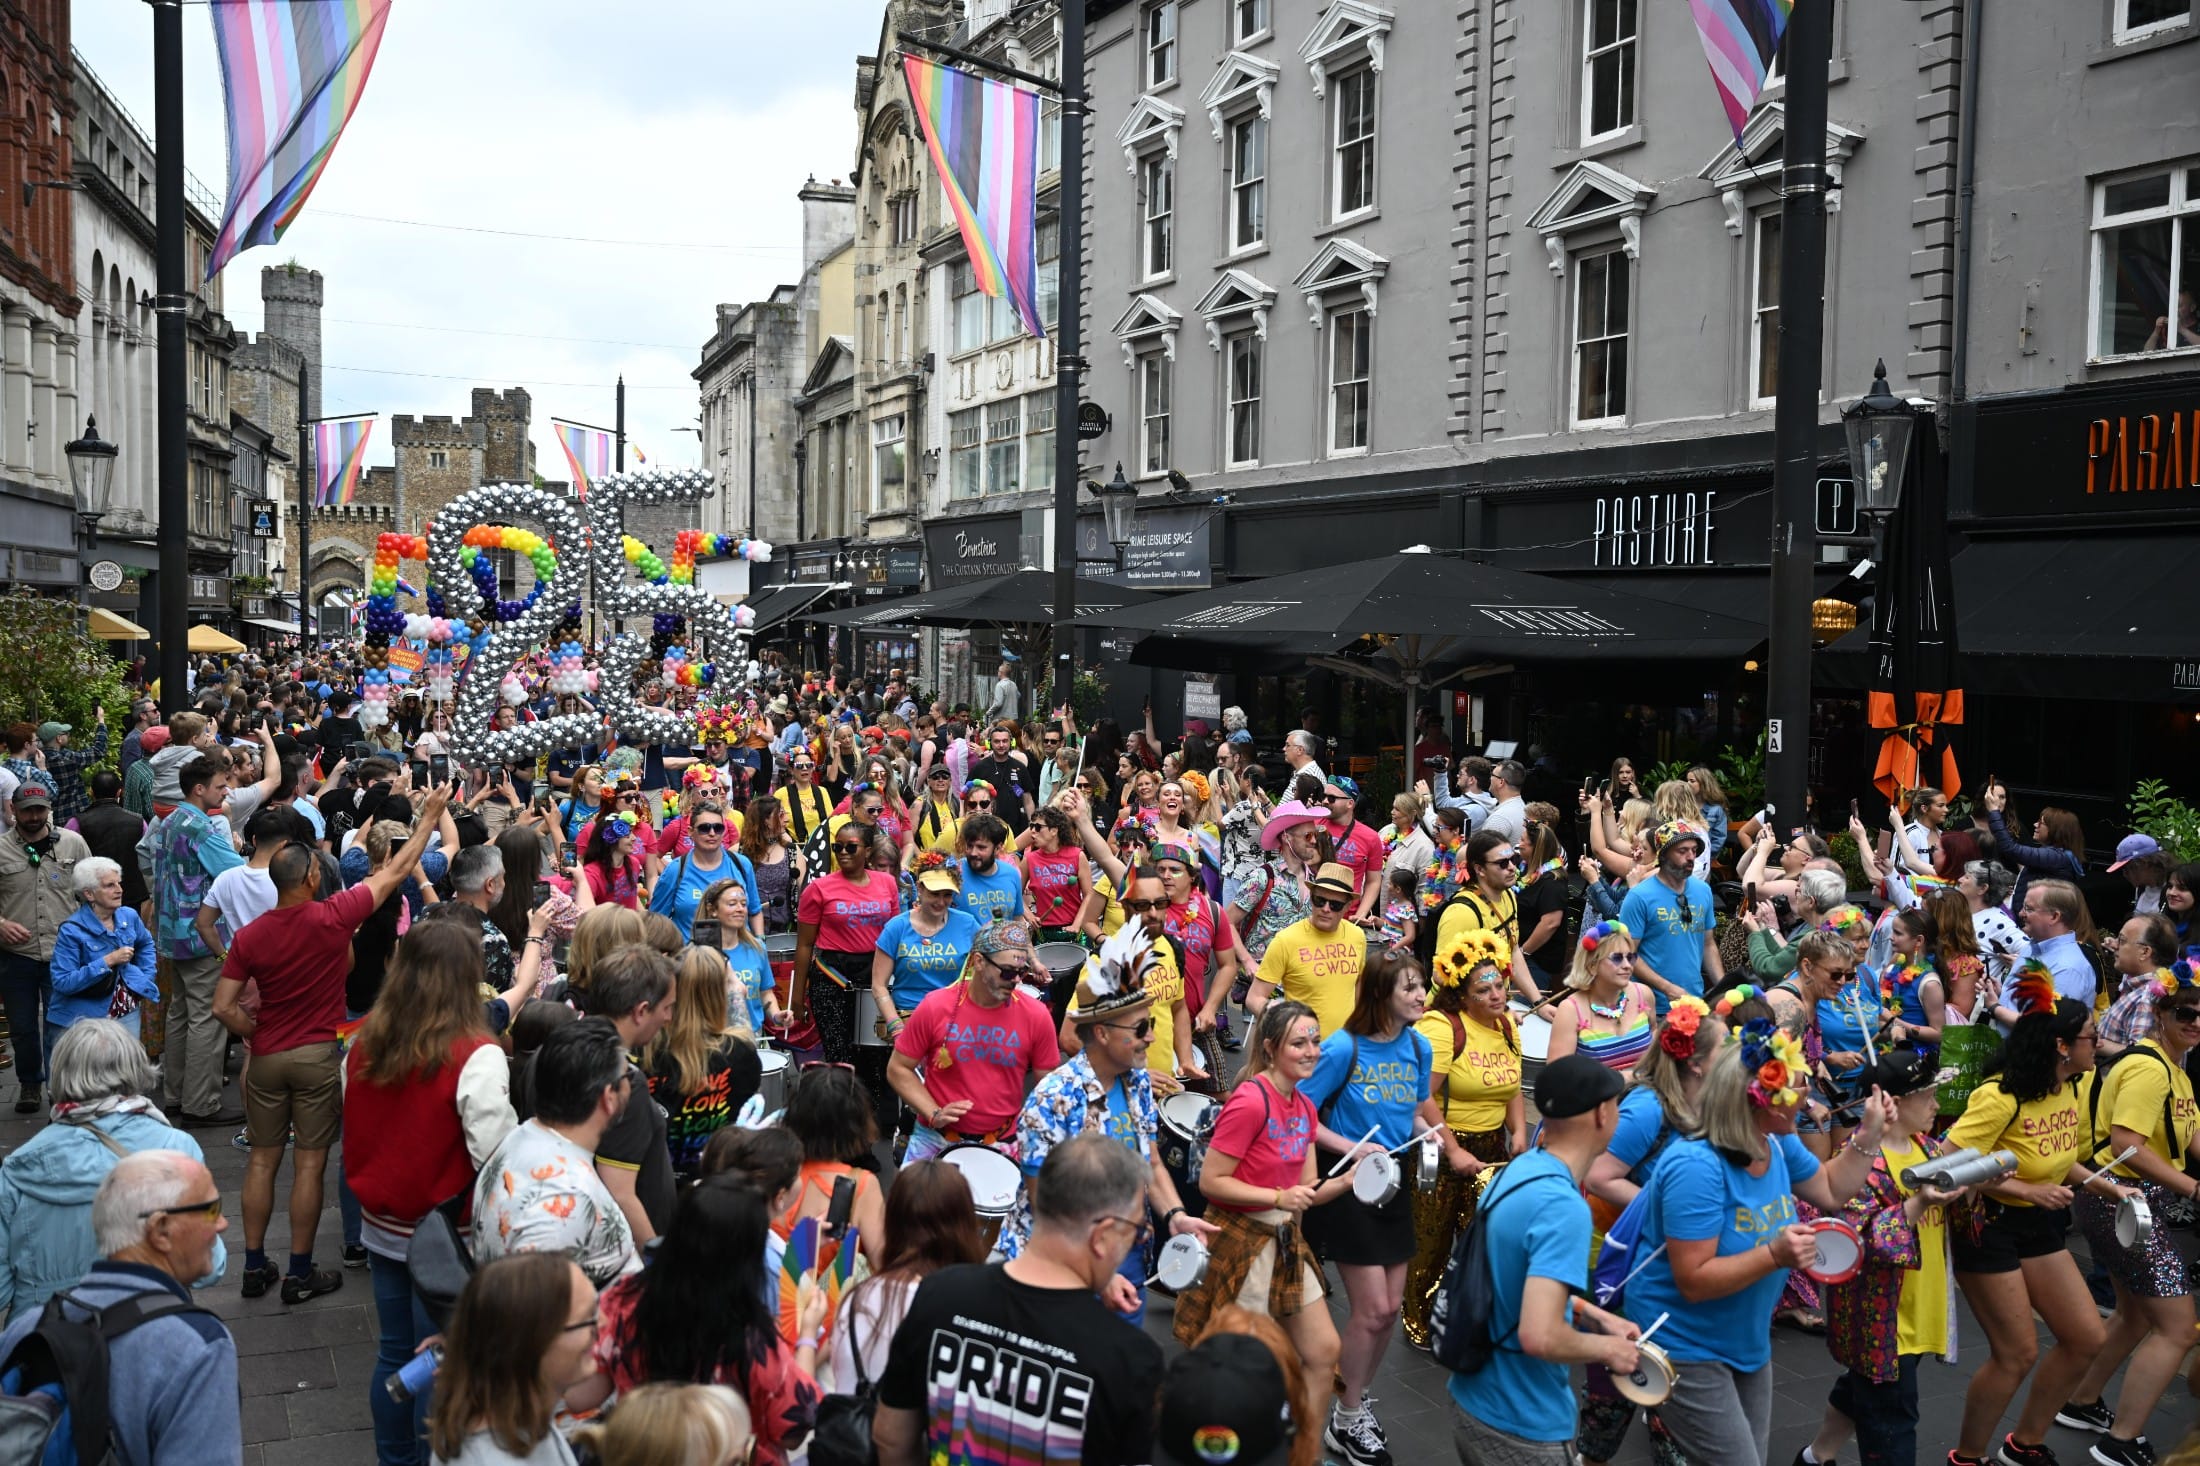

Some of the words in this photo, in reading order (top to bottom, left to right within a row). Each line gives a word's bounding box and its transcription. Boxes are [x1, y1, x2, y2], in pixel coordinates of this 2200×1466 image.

[253, 505, 272, 513] BLUE
[1832, 483, 1842, 529] P
[254, 528, 272, 536] BELL
[1593, 491, 1716, 566] PASTURE
[1147, 533, 1172, 546] LEISURE
[1173, 532, 1193, 545] SPACE
[941, 564, 954, 576] THE
[954, 562, 981, 576] CURTAIN
[1085, 567, 1114, 577] QUARTER
[1480, 609, 1625, 630] PASTURE
[1770, 722, 1778, 734] 5
[1770, 738, 1779, 751] A
[1033, 863, 1076, 877] BARRA
[1041, 874, 1070, 888] CWD
[968, 891, 1013, 905] BARRA
[836, 901, 891, 915] BARRA
[898, 942, 958, 957] BARRA
[1299, 943, 1357, 962] BARRA
[907, 957, 958, 972] CWDA
[1313, 959, 1359, 976] CWDA
[946, 1023, 1021, 1048] BARRA
[956, 1044, 1017, 1068] CWDA
[1350, 1062, 1416, 1084] BARRA
[682, 1087, 731, 1114] LOVE
[1362, 1084, 1417, 1104] CWDA
[683, 1106, 730, 1134] LOVE
[1005, 1331, 1019, 1344] IS
[1018, 1335, 1078, 1364] BEAUTIFUL
[928, 1328, 1095, 1433] PRIDE
